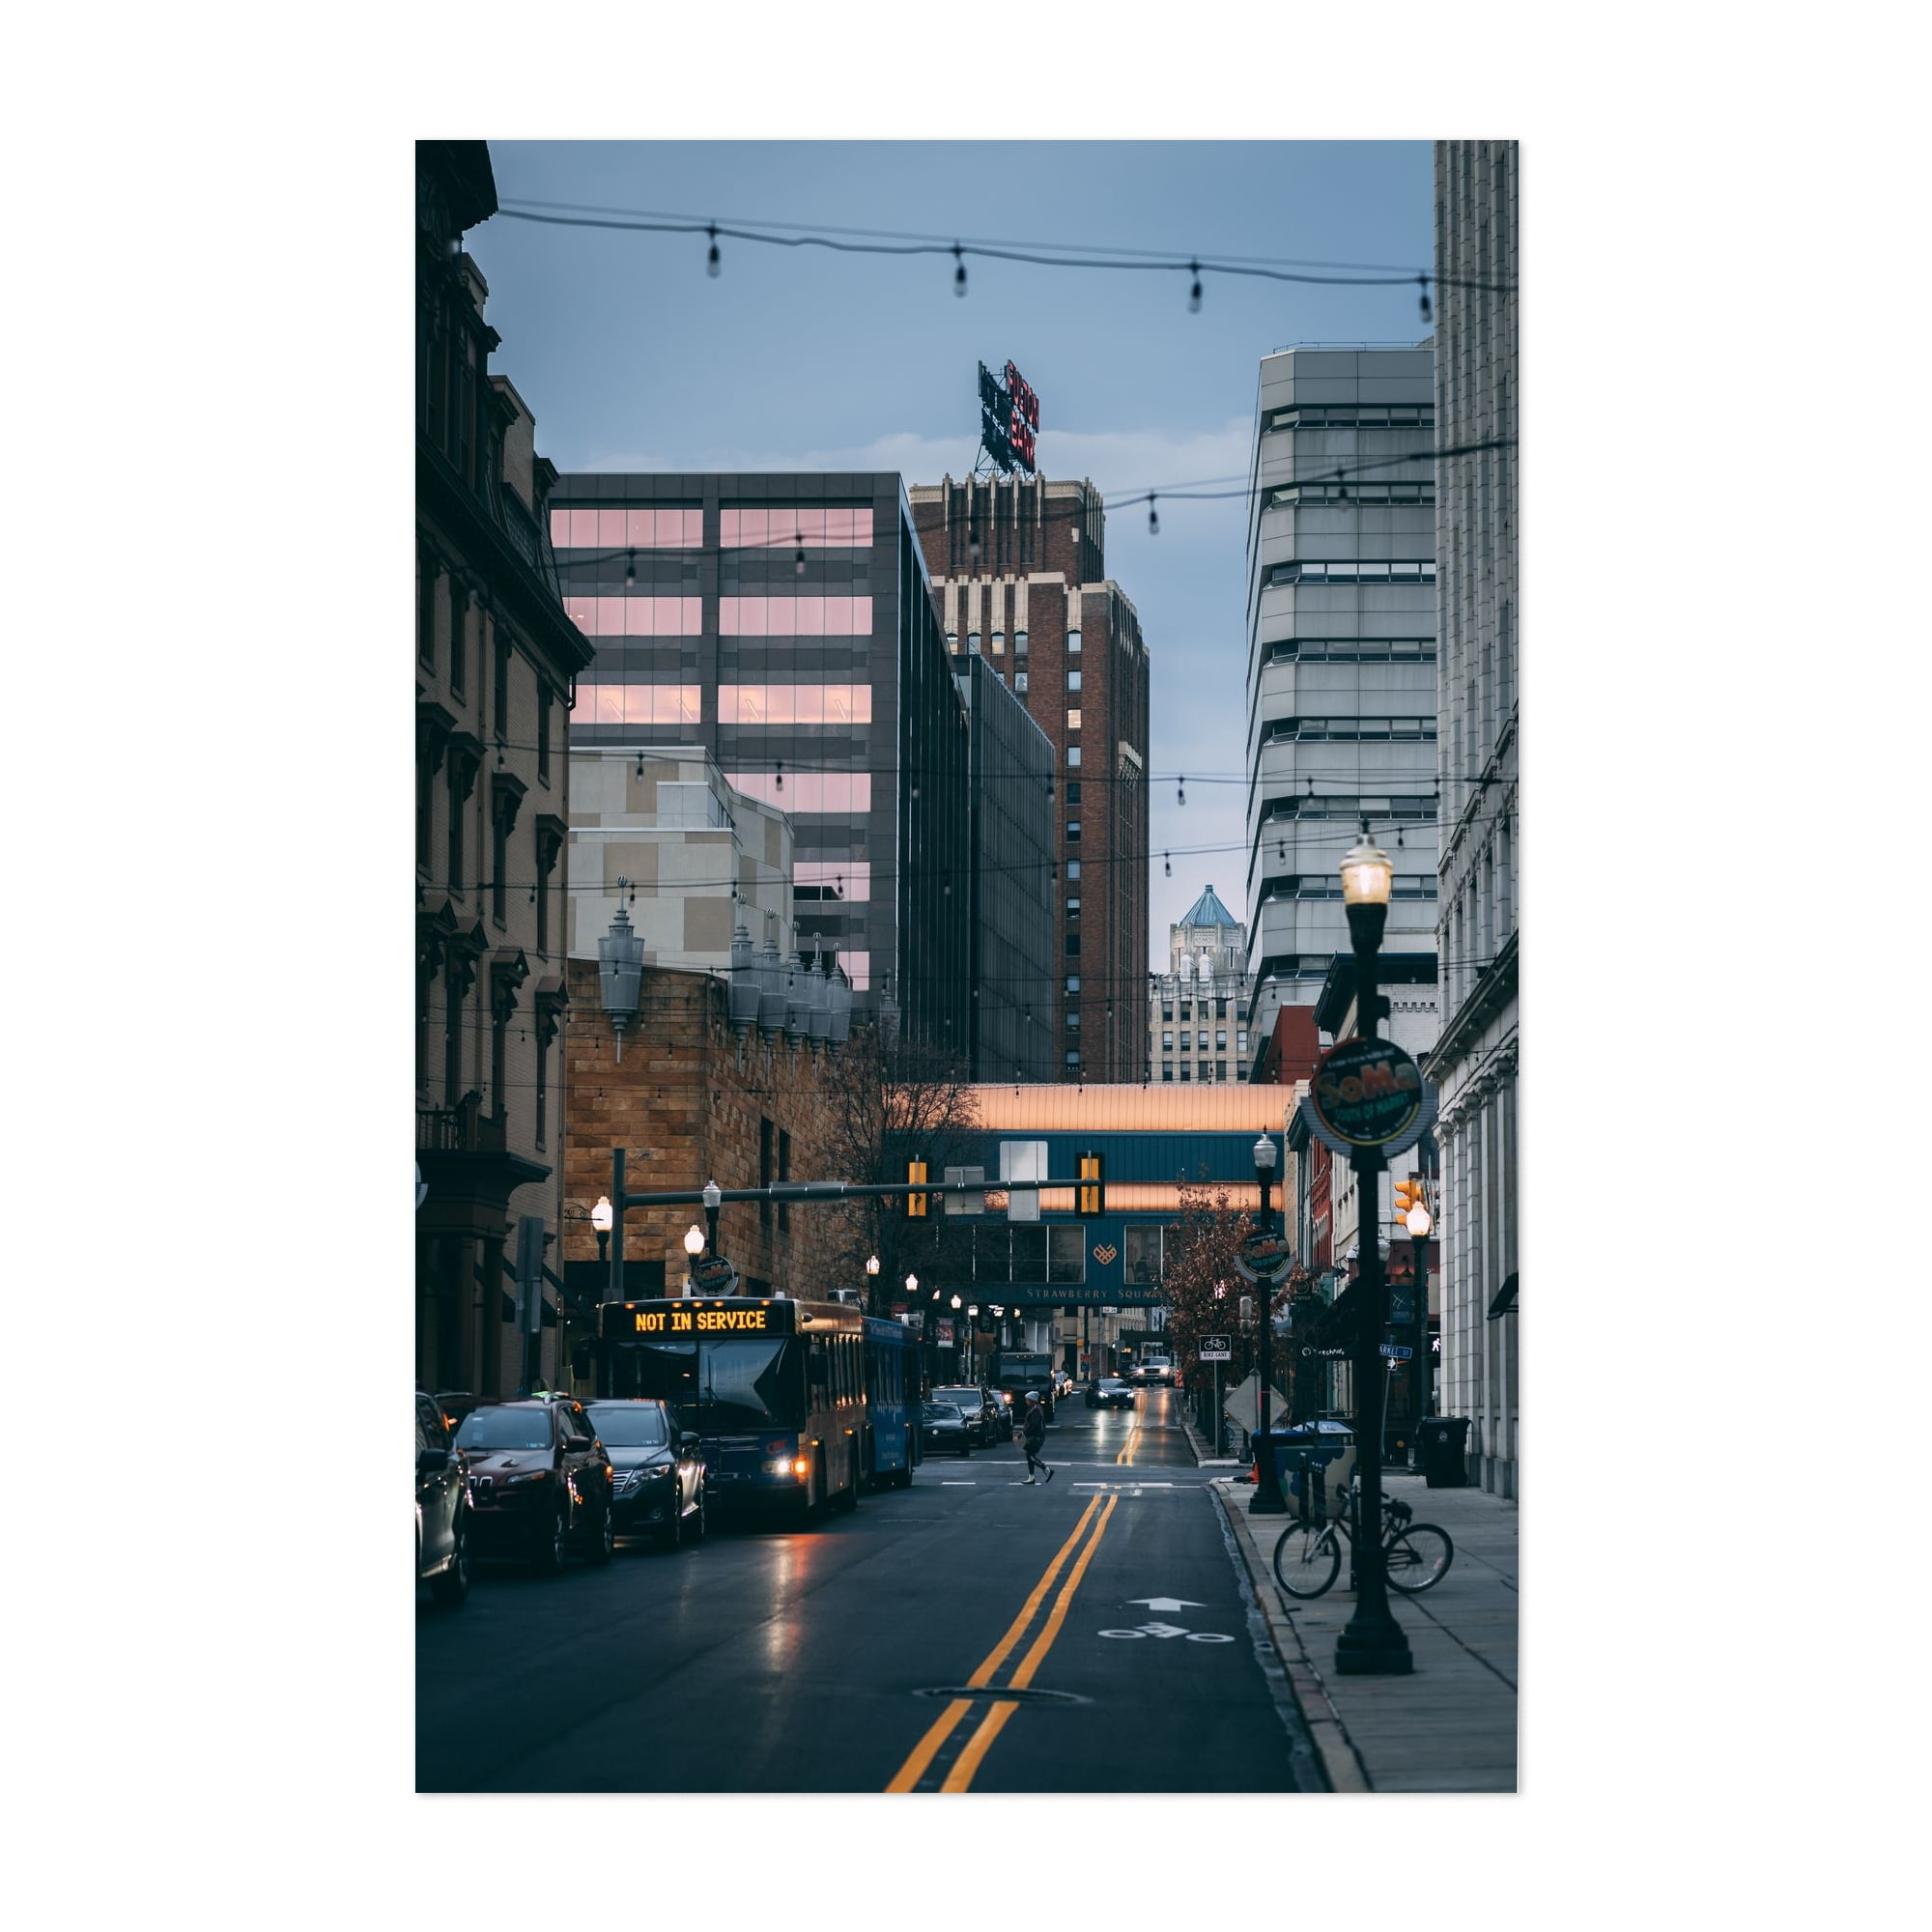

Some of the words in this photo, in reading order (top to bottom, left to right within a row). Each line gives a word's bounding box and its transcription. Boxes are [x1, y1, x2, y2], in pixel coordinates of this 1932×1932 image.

[1027, 1288, 1107, 1299] STRAWBERRY
[636, 1313, 666, 1331] NOT
[671, 1312, 693, 1331] IN
[696, 1310, 766, 1330] SERVICE
[1378, 1345, 1399, 1356] ARKET
